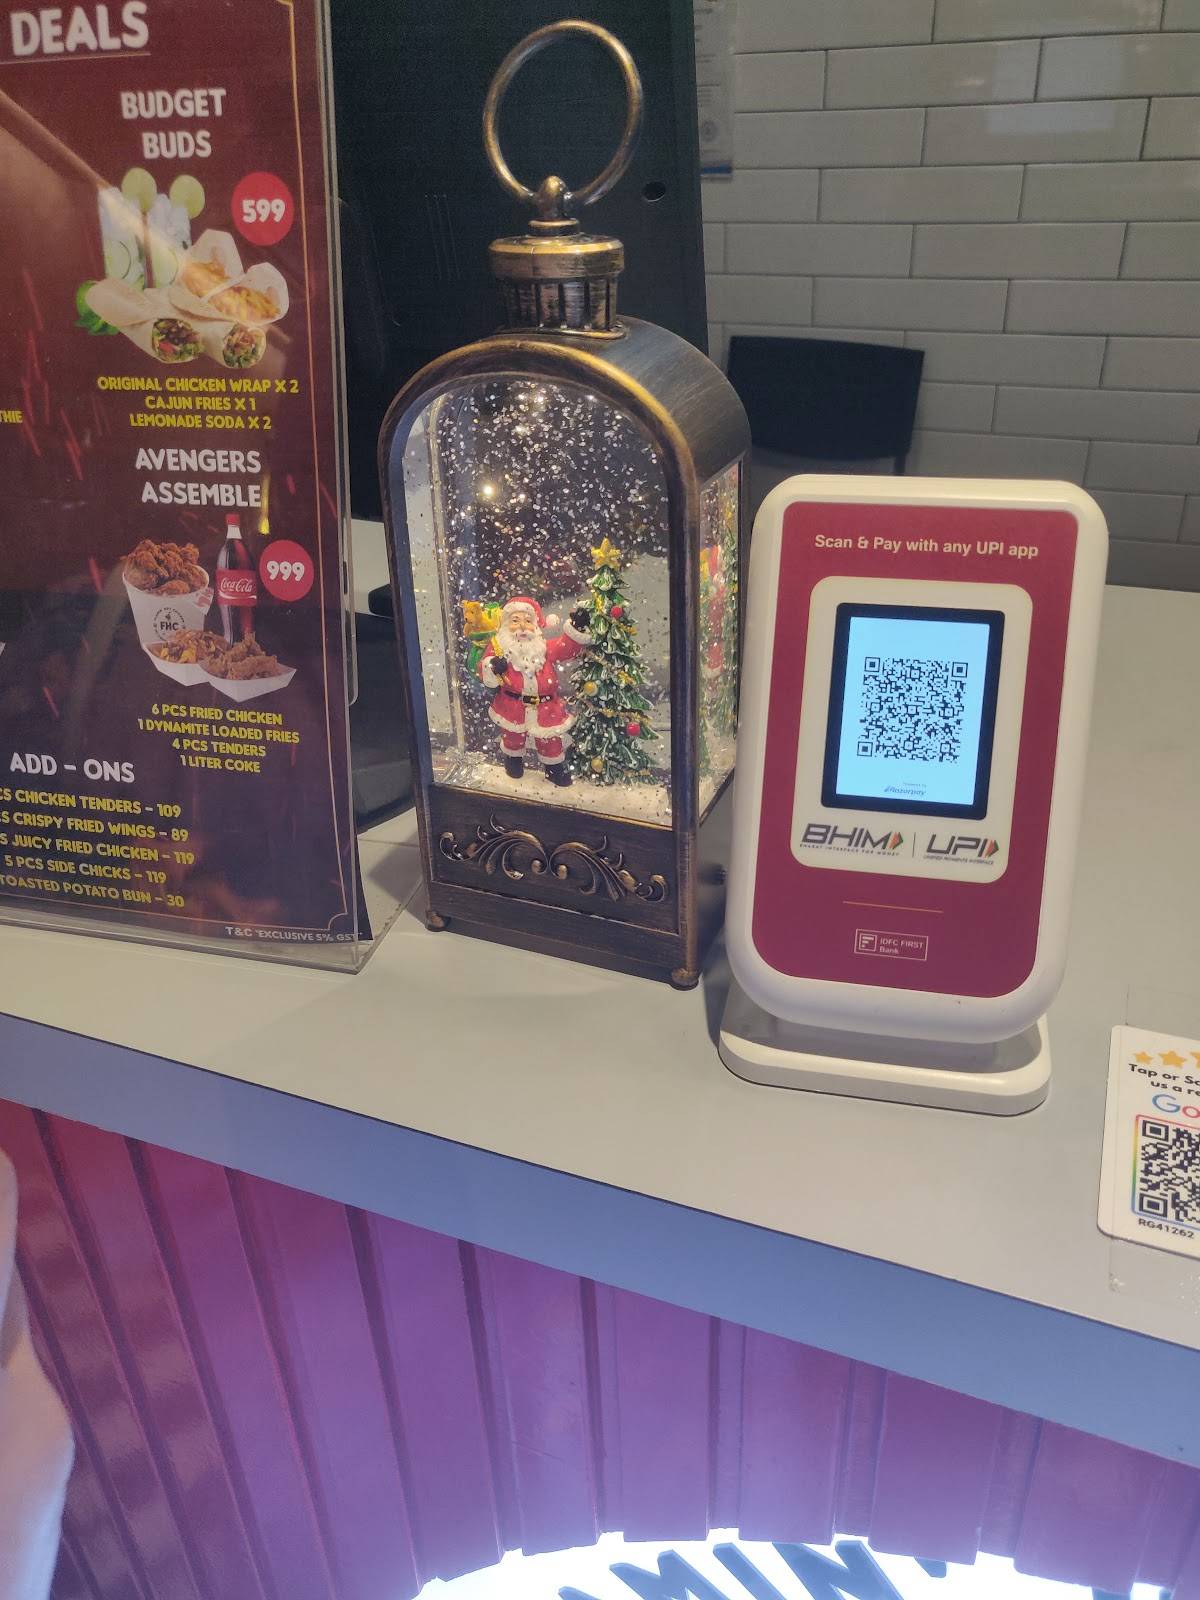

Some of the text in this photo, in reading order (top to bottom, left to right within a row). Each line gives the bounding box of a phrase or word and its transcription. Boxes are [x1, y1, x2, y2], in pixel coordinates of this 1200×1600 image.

[10, 0, 149, 56] DEALS
[121, 88, 226, 119] BUDGET
[142, 130, 212, 159] BUDS
[242, 198, 285, 223] 599
[98, 377, 162, 391] ORIGINAL
[166, 378, 226, 392] CHICKEN
[230, 379, 271, 393] WRAP
[145, 396, 192, 410] CAJUN
[195, 397, 231, 410] FRIES
[129, 413, 202, 428] LEMONADE
[206, 415, 245, 429] SODA
[135, 448, 262, 474] AVENGERS
[142, 481, 262, 507] ASSEMBLE
[815, 534, 1039, 559] Scan & Pay with any UPI app
[267, 560, 304, 581] 999
[160, 621, 179, 630] FHC
[152, 704, 283, 725] 6 PCS FRIED CHICKEN
[212, 725, 263, 741] LOADED
[266, 730, 299, 744] FRIES
[172, 738, 267, 757] 4 PCS TENDERS
[10, 752, 57, 776] ADD
[84, 759, 135, 783] ONS
[189, 755, 222, 770] LITER
[225, 759, 260, 773] COKE
[15, 789, 76, 808] CHICKEN
[79, 795, 141, 814] TENDERS
[157, 804, 181, 818] 109
[13, 812, 63, 829] CRISPY
[67, 818, 104, 833] FRIED
[108, 822, 155, 839] WINGS
[171, 828, 188, 841] 89
[802, 823, 893, 849] BHIM
[12, 834, 52, 850] JUICY
[56, 839, 93, 855] FRIED
[96, 843, 159, 861] CHICKEN
[175, 852, 194, 864] 119
[927, 834, 988, 857] UPI
[4, 855, 13, 867] 5
[16, 856, 44, 870] PCS
[47, 860, 76, 874] SIDE
[79, 863, 131, 880] CHICKS
[146, 871, 166, 883] 119
[63, 882, 119, 899] POTATO
[122, 889, 151, 903] BUN
[167, 895, 184, 907] 30
[225, 926, 253, 937] T&C
[316, 933, 334, 942] 5%
[901, 940, 924, 949] FIRST
[1128, 1063, 1158, 1078] Tap
[1162, 1073, 1180, 1081] or
[1150, 1081, 1168, 1089] us
[1138, 1218, 1194, 1240] RG41262
